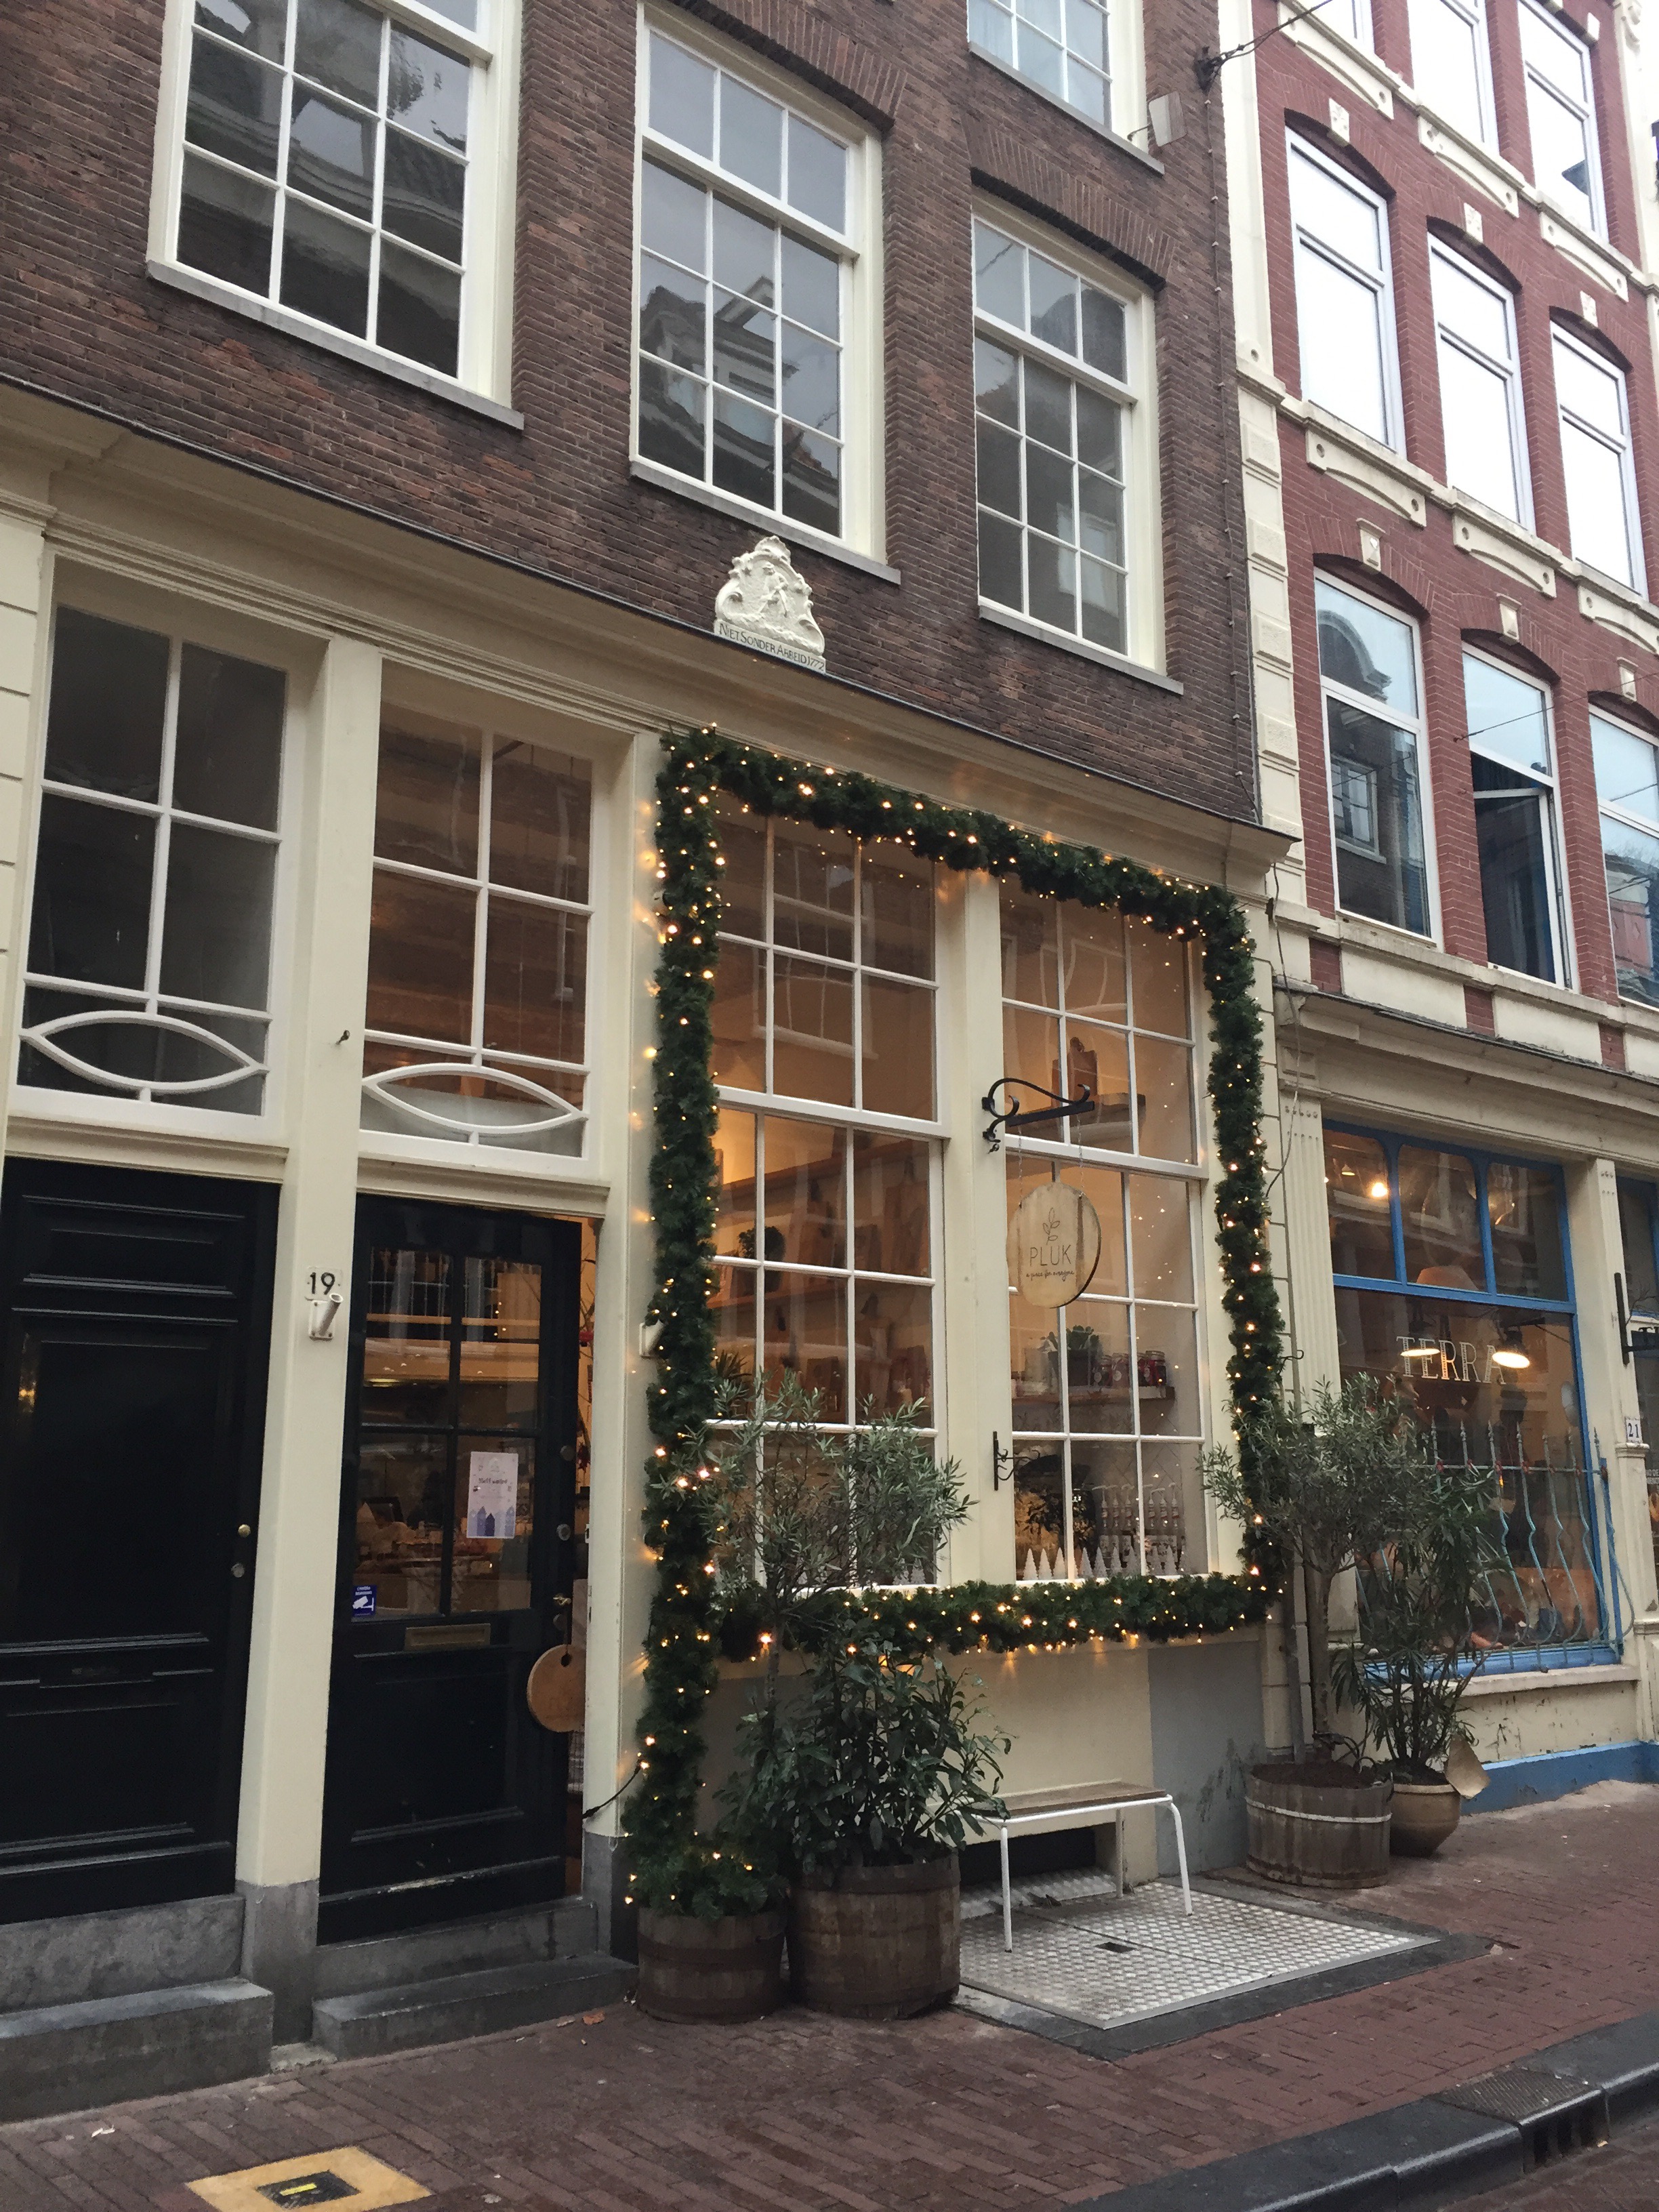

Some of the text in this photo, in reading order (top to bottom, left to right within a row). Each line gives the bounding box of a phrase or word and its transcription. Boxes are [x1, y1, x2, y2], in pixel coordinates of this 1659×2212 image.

[740, 632, 776, 653] SONDER
[777, 645, 807, 664] ARBEID
[807, 655, 825, 672] 1772
[1029, 1244, 1071, 1267] PLUK
[310, 1271, 335, 1295] 19
[1396, 1336, 1507, 1385] TERRA
[1627, 1422, 1640, 1439] 21
